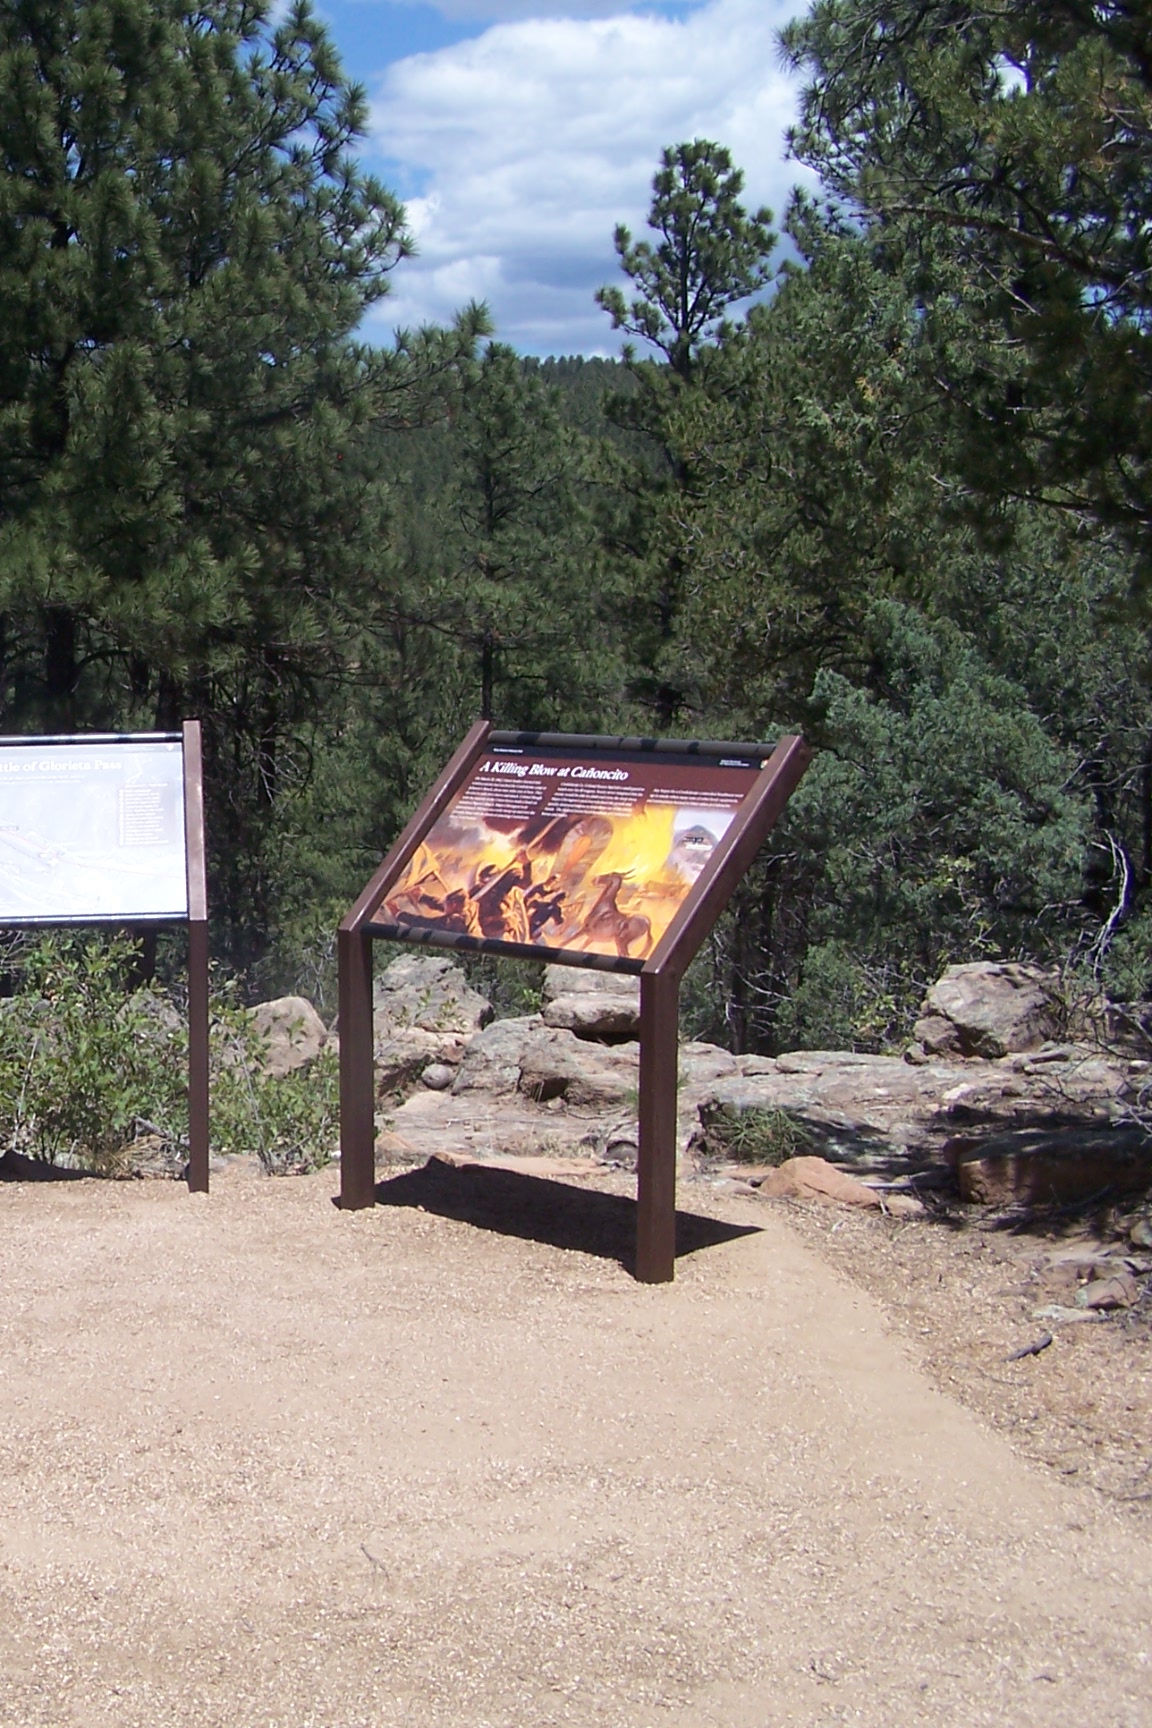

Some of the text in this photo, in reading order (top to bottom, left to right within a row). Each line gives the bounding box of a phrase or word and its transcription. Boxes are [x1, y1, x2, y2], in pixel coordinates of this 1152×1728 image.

[23, 761, 37, 772] of
[39, 760, 91, 772] Glorieta
[95, 759, 122, 770] Pass
[478, 761, 629, 781] A Killing Blow at Cañoncito
